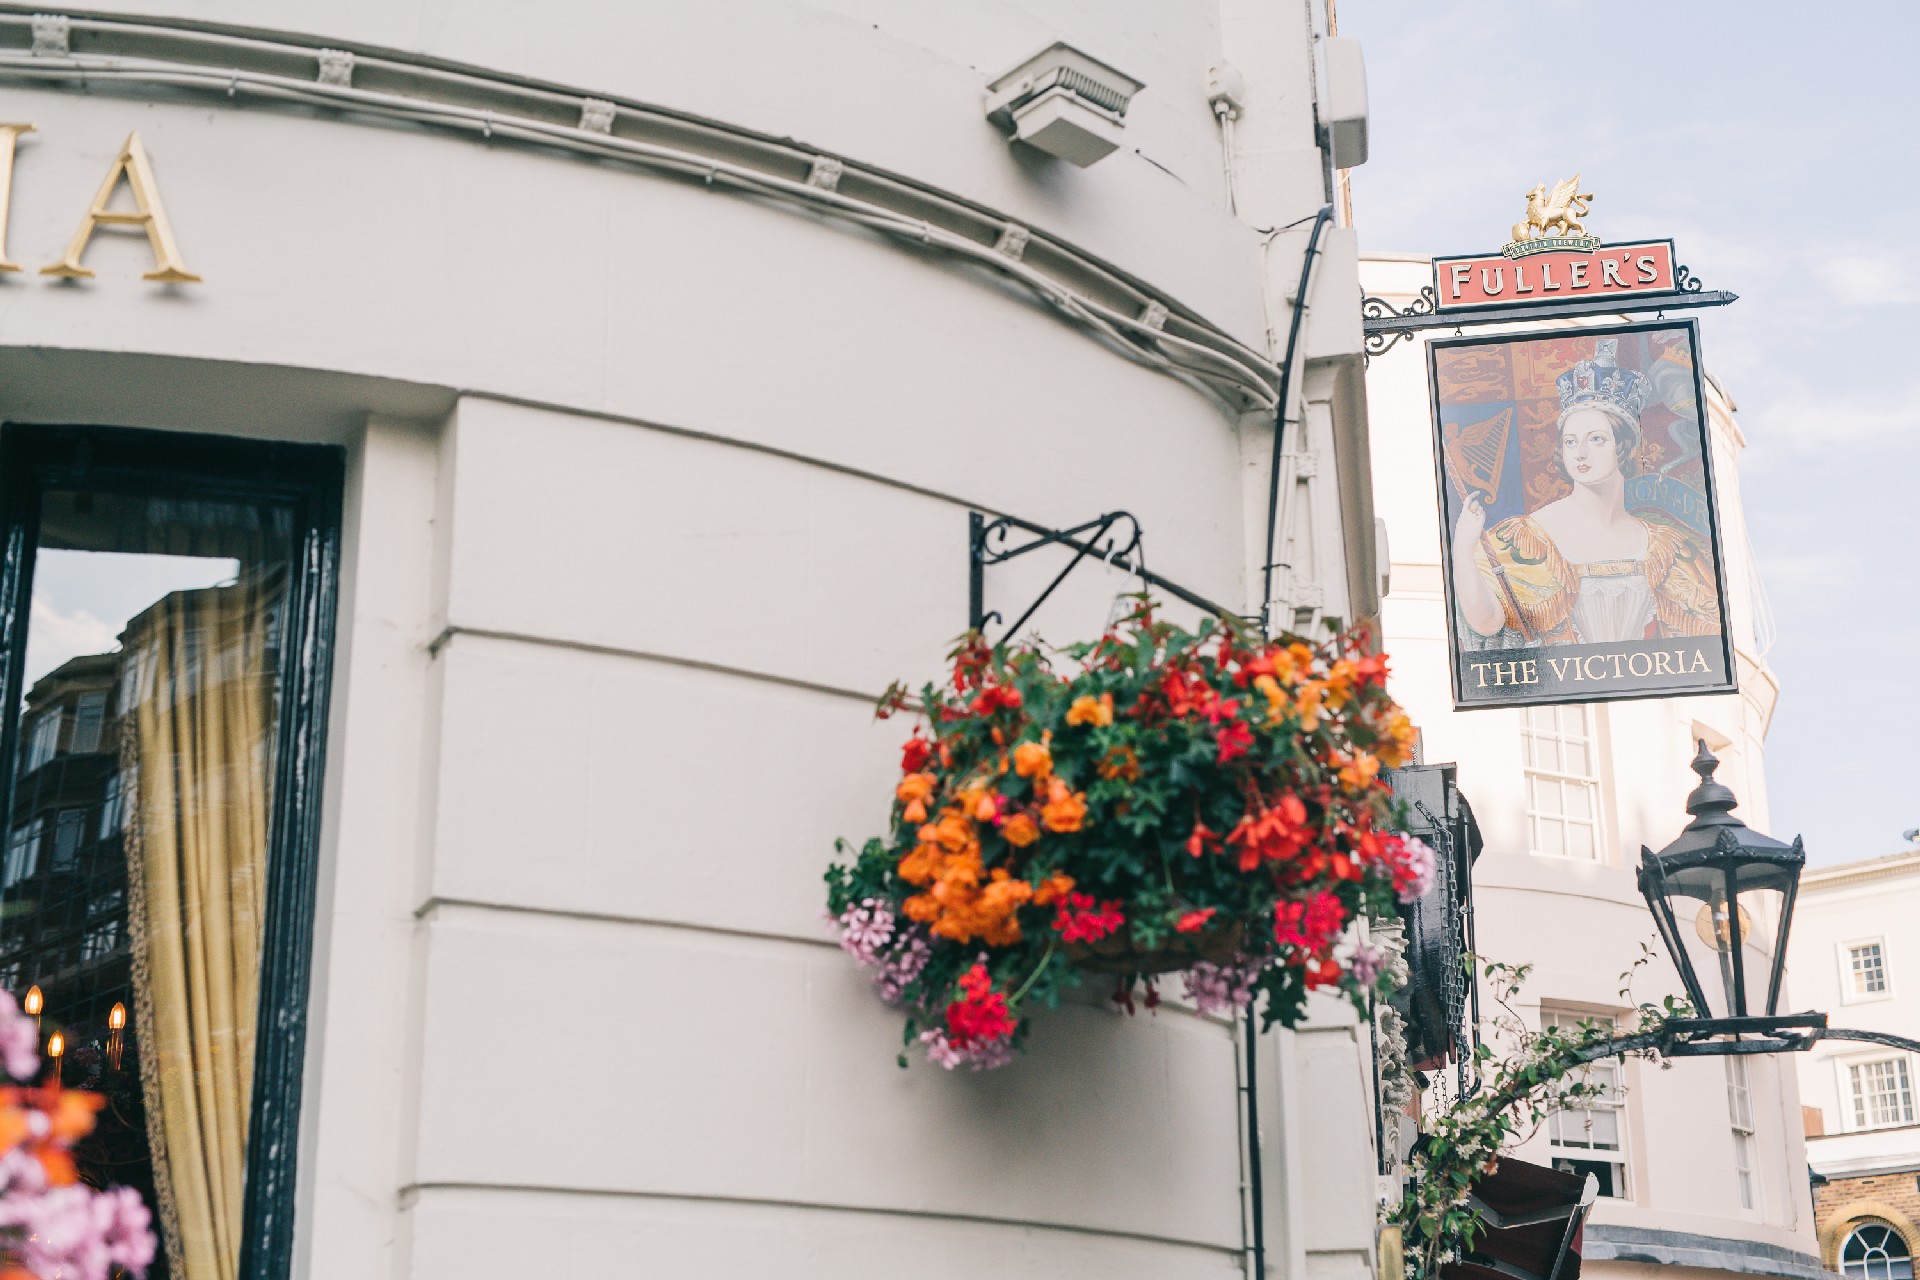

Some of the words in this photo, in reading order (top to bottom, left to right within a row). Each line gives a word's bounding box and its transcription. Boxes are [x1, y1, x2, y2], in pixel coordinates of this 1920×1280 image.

[1451, 253, 1658, 298] FULLER'S
[1471, 659, 1539, 687] THE
[1547, 648, 1712, 681] VICTORIA
